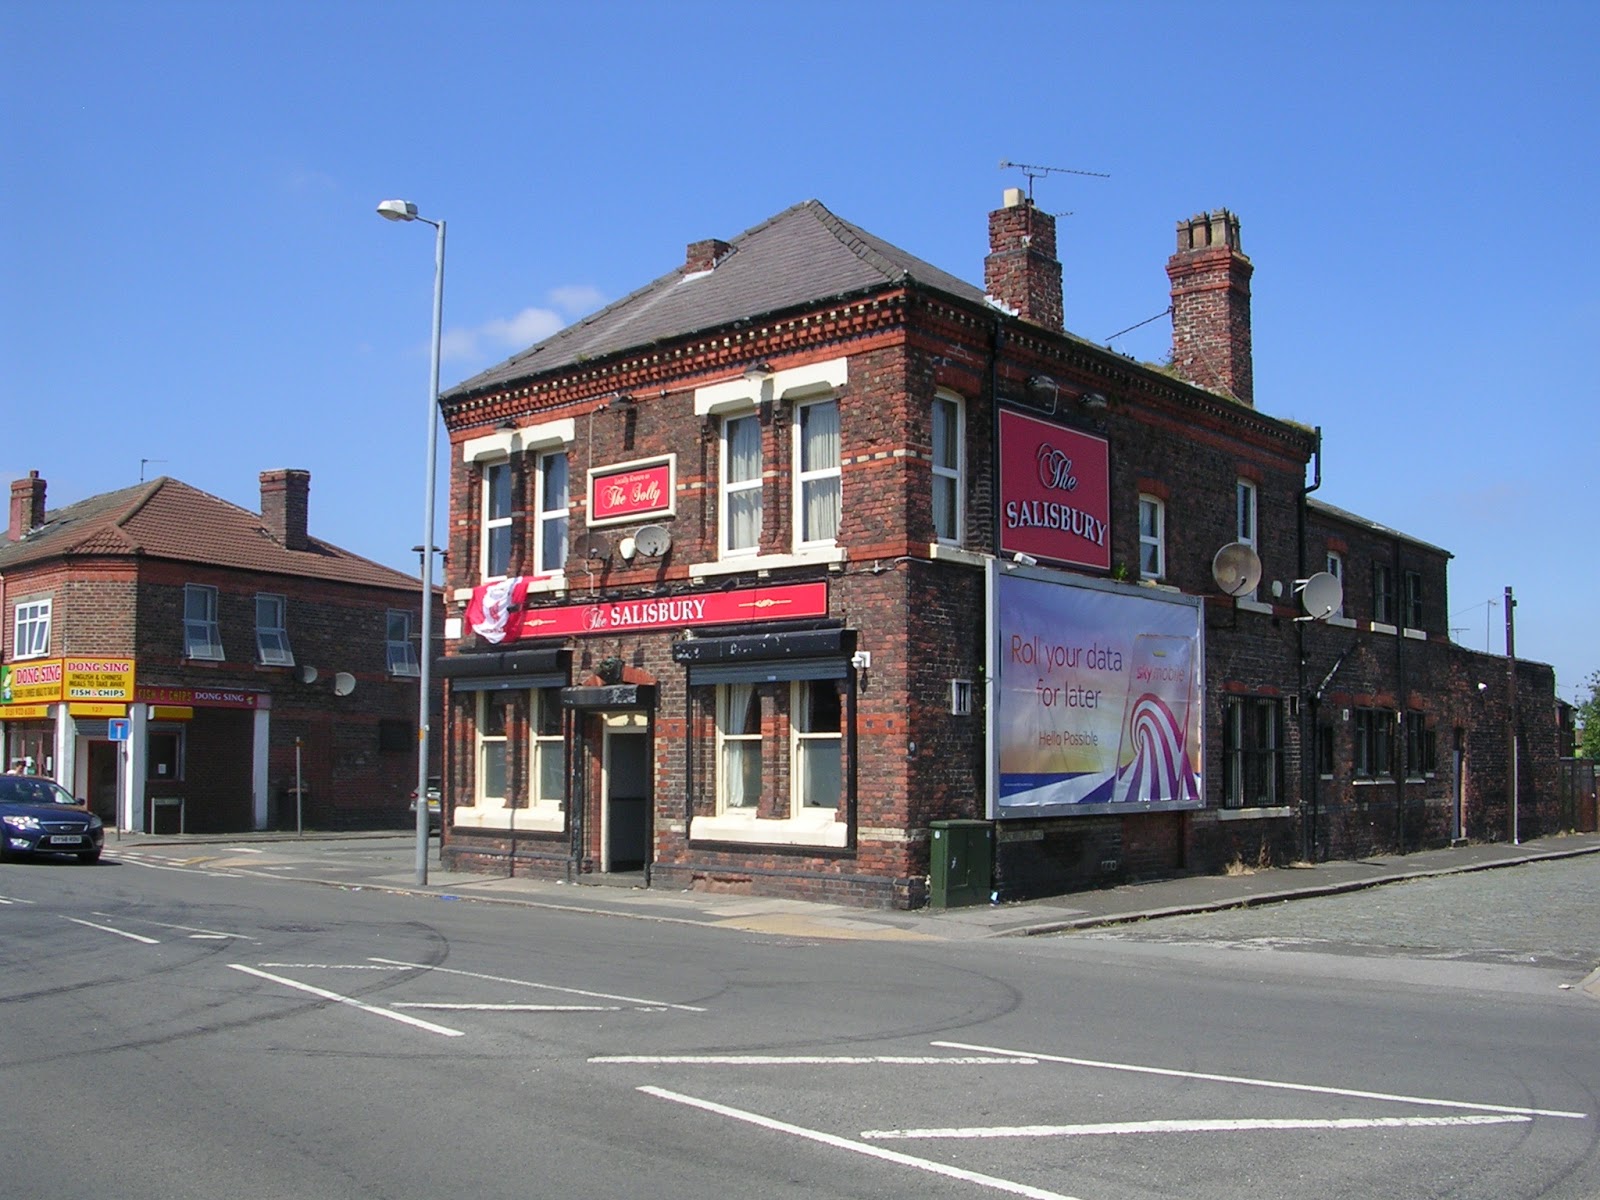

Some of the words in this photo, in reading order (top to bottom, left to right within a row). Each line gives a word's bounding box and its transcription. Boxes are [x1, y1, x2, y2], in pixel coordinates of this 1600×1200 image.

[1037, 442, 1078, 492] The
[601, 485, 627, 509] The
[1006, 500, 1107, 547] SALISBURY
[581, 607, 607, 631] The
[610, 599, 705, 626] SALISBURY
[1011, 634, 1040, 665] Roll
[1045, 645, 1082, 674] your
[1086, 642, 1122, 672] data
[16, 668, 39, 684] DONG
[41, 665, 61, 682] SING
[68, 663, 100, 671] DONG
[102, 663, 129, 672] SING
[1136, 664, 1152, 684] sky
[98, 689, 125, 697] CHIPS
[169, 690, 192, 702] CHIPS
[195, 691, 222, 701] DONG
[223, 692, 245, 702] SING
[1036, 678, 1060, 707] for
[1065, 681, 1102, 709] later
[1039, 731, 1061, 746] Hello
[1063, 730, 1098, 746] Possible
